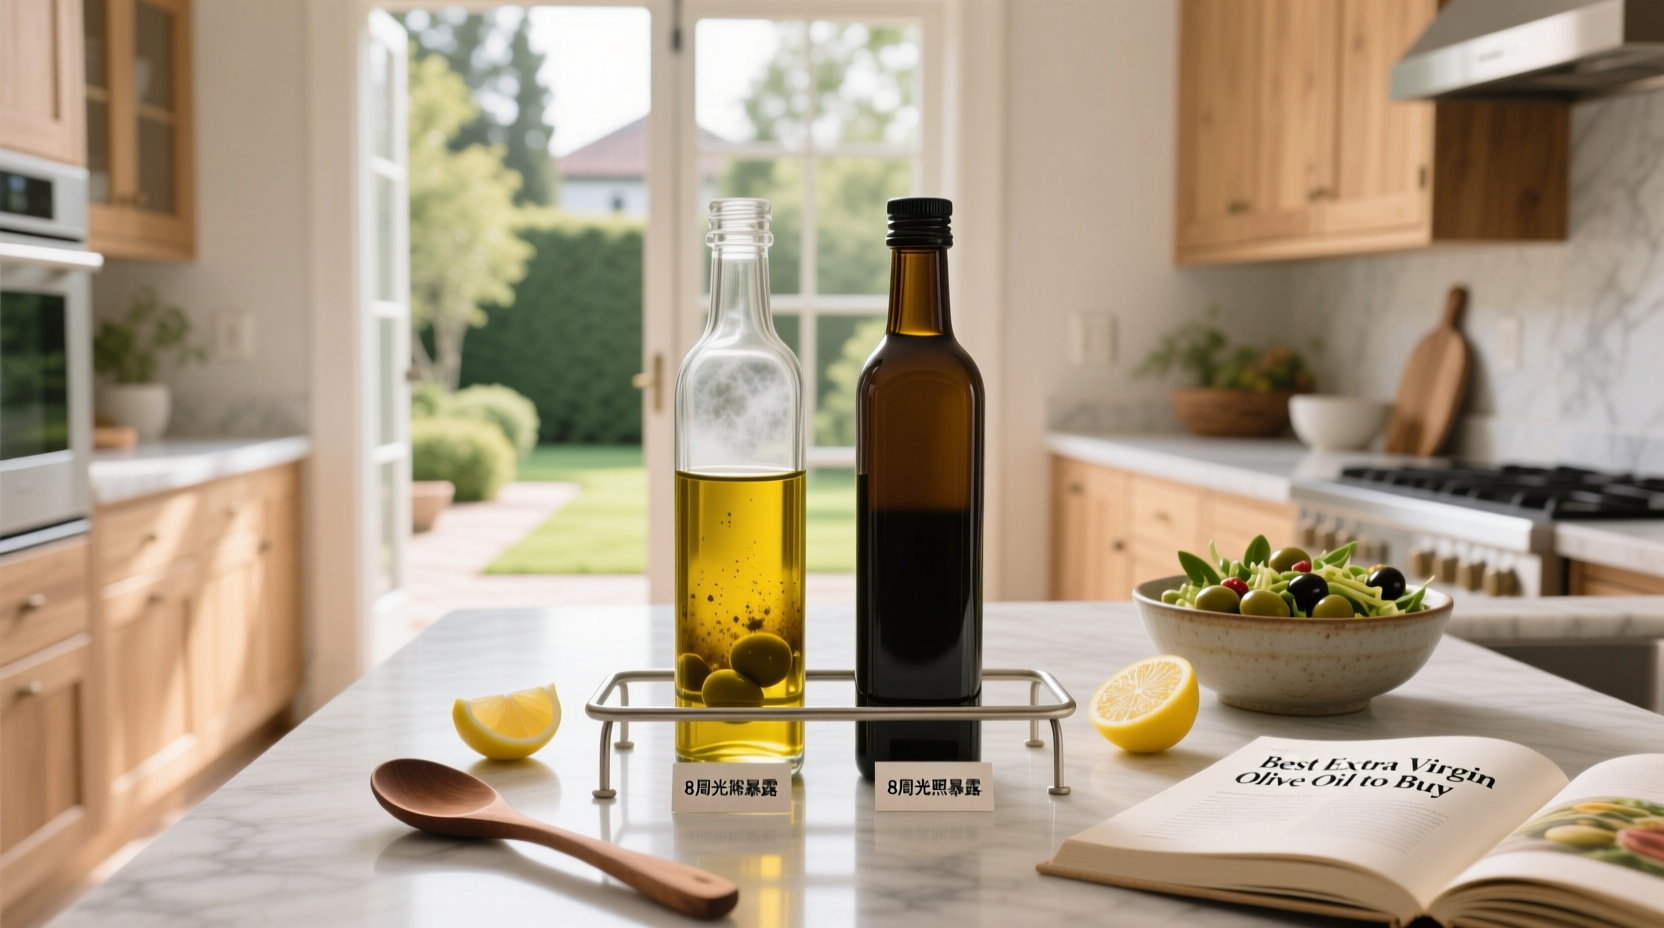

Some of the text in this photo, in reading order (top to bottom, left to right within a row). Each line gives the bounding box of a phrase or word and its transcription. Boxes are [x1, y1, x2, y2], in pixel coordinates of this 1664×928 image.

[1235, 771, 1454, 799] Olive Oil to Buy
[1259, 755, 1496, 790] Best Extra Virgin
